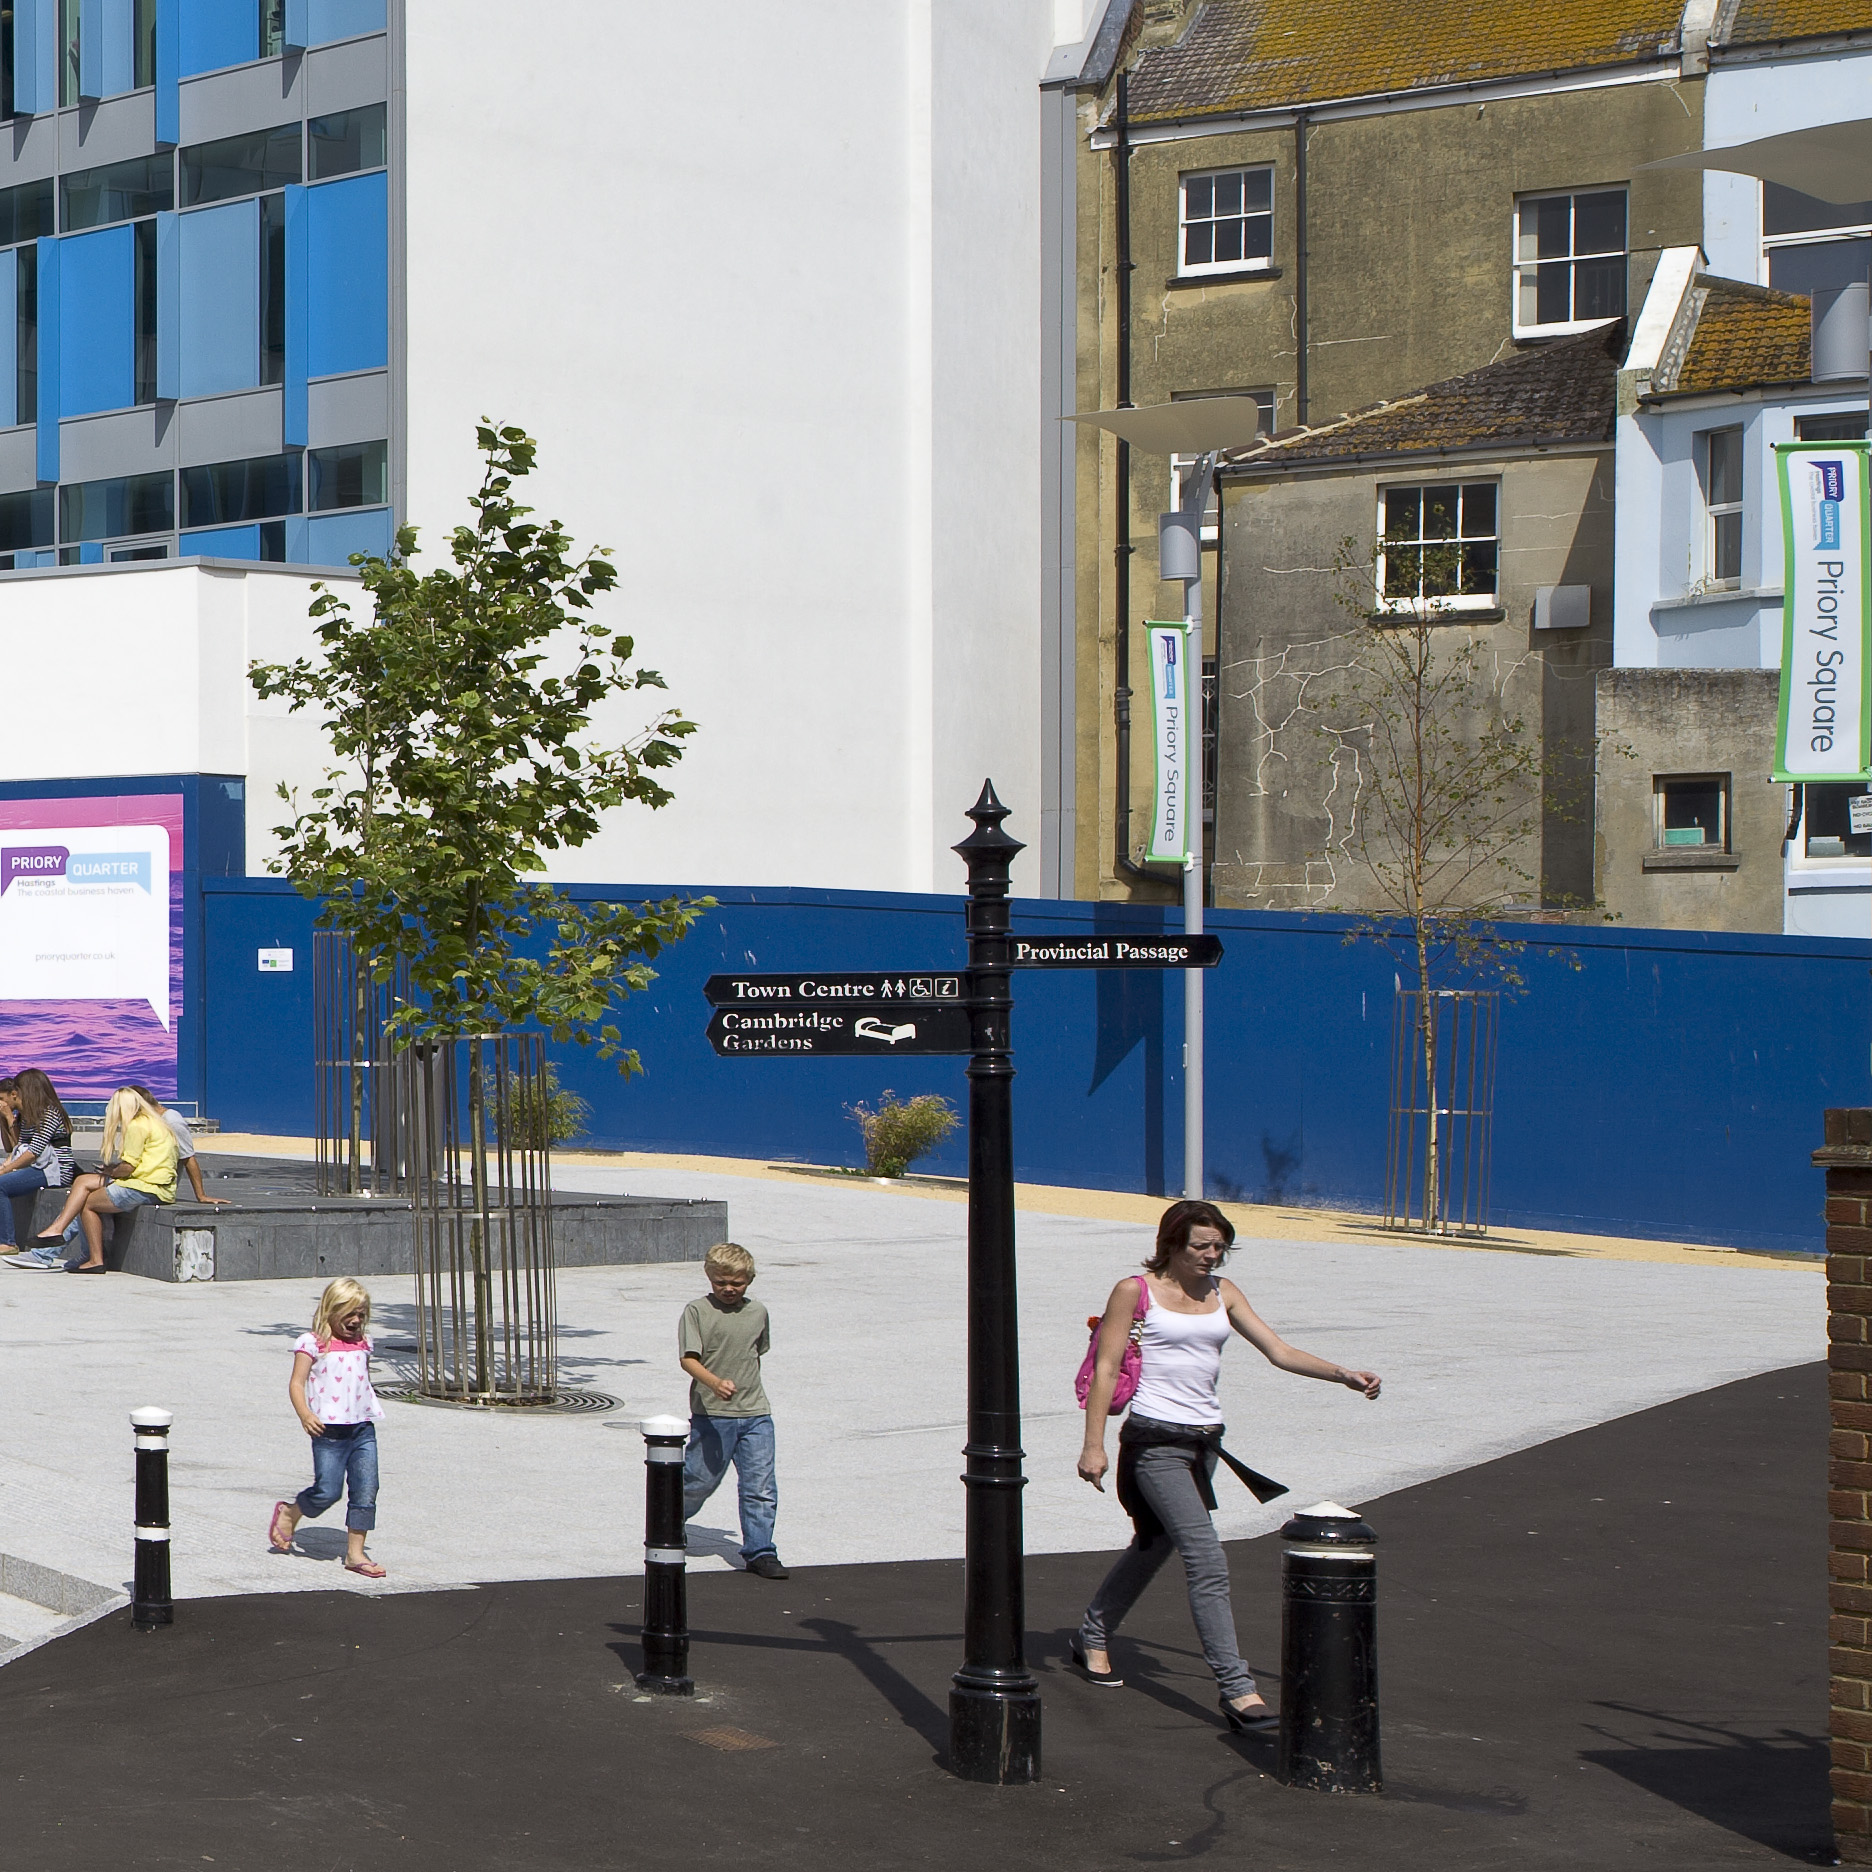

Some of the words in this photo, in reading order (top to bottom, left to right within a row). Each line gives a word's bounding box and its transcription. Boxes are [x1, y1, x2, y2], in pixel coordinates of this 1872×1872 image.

[1809, 561, 1844, 641] Priory
[1806, 650, 1844, 752] Square
[1164, 706, 1179, 763] Priory
[1163, 769, 1179, 842] Square
[11, 856, 62, 869] PRIORY
[72, 862, 138, 876] QUARTER
[17, 879, 56, 888] Hastings
[34, 888, 66, 896] coastal
[67, 887, 105, 896] business
[108, 886, 134, 895] haven
[35, 952, 116, 962] prioryquarter.co.uk
[1016, 943, 1109, 960] Provincial
[1115, 943, 1189, 962] Passage
[731, 981, 792, 998] Town
[798, 981, 875, 997] Centre
[722, 1012, 844, 1032] Cambridge
[722, 1034, 813, 1050] Gardens
